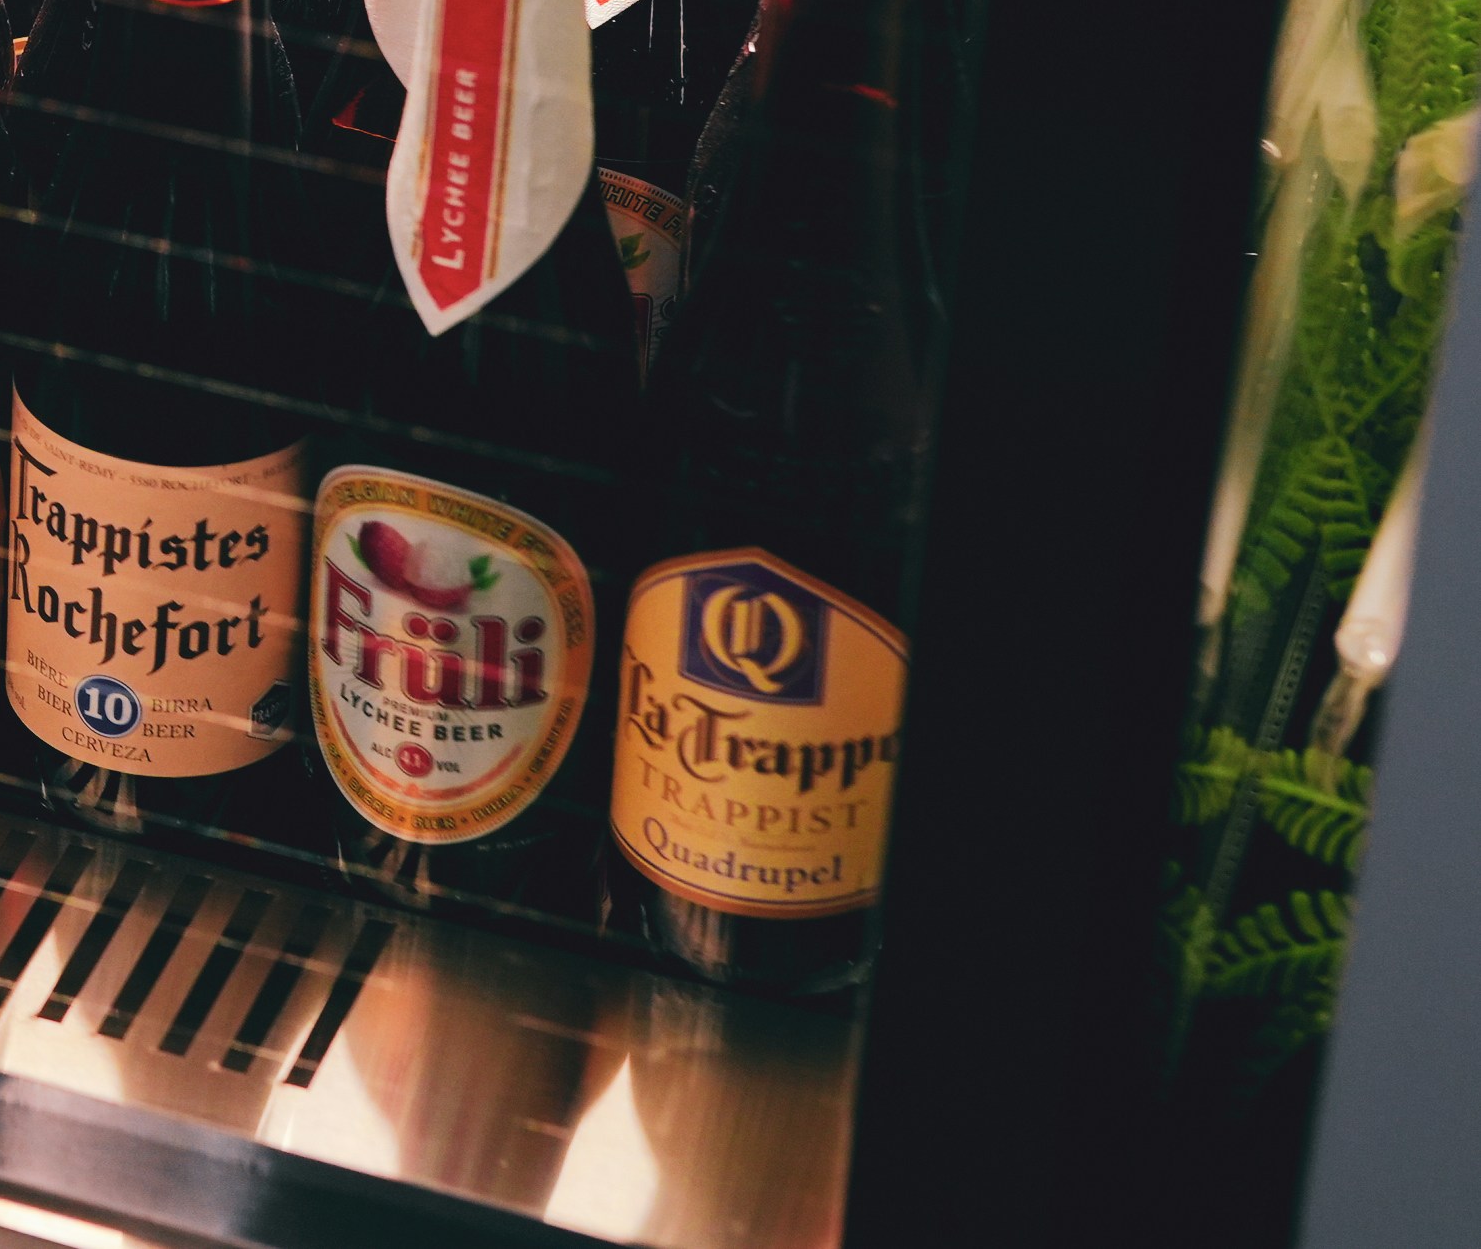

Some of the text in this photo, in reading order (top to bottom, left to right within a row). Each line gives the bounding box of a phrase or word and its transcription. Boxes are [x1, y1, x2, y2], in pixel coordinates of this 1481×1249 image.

[432, 70, 478, 271] LYCHEE BEER
[599, 180, 664, 221] HITE
[13, 436, 270, 577] Trappistes
[11, 520, 269, 675] Rochefort
[322, 554, 547, 711] Früli
[702, 585, 804, 694] Q
[26, 648, 69, 689] BIÈRE
[37, 684, 73, 717] BIER
[624, 643, 672, 752] La
[84, 687, 133, 726] 10
[142, 723, 196, 739] BEER
[151, 697, 213, 714] BIRRA
[340, 683, 422, 737] LYCHEE
[433, 723, 504, 743] BEER
[61, 726, 152, 763] CERVEZA
[638, 756, 868, 834] TRAPPIST
[642, 815, 842, 894] Quadrupel
